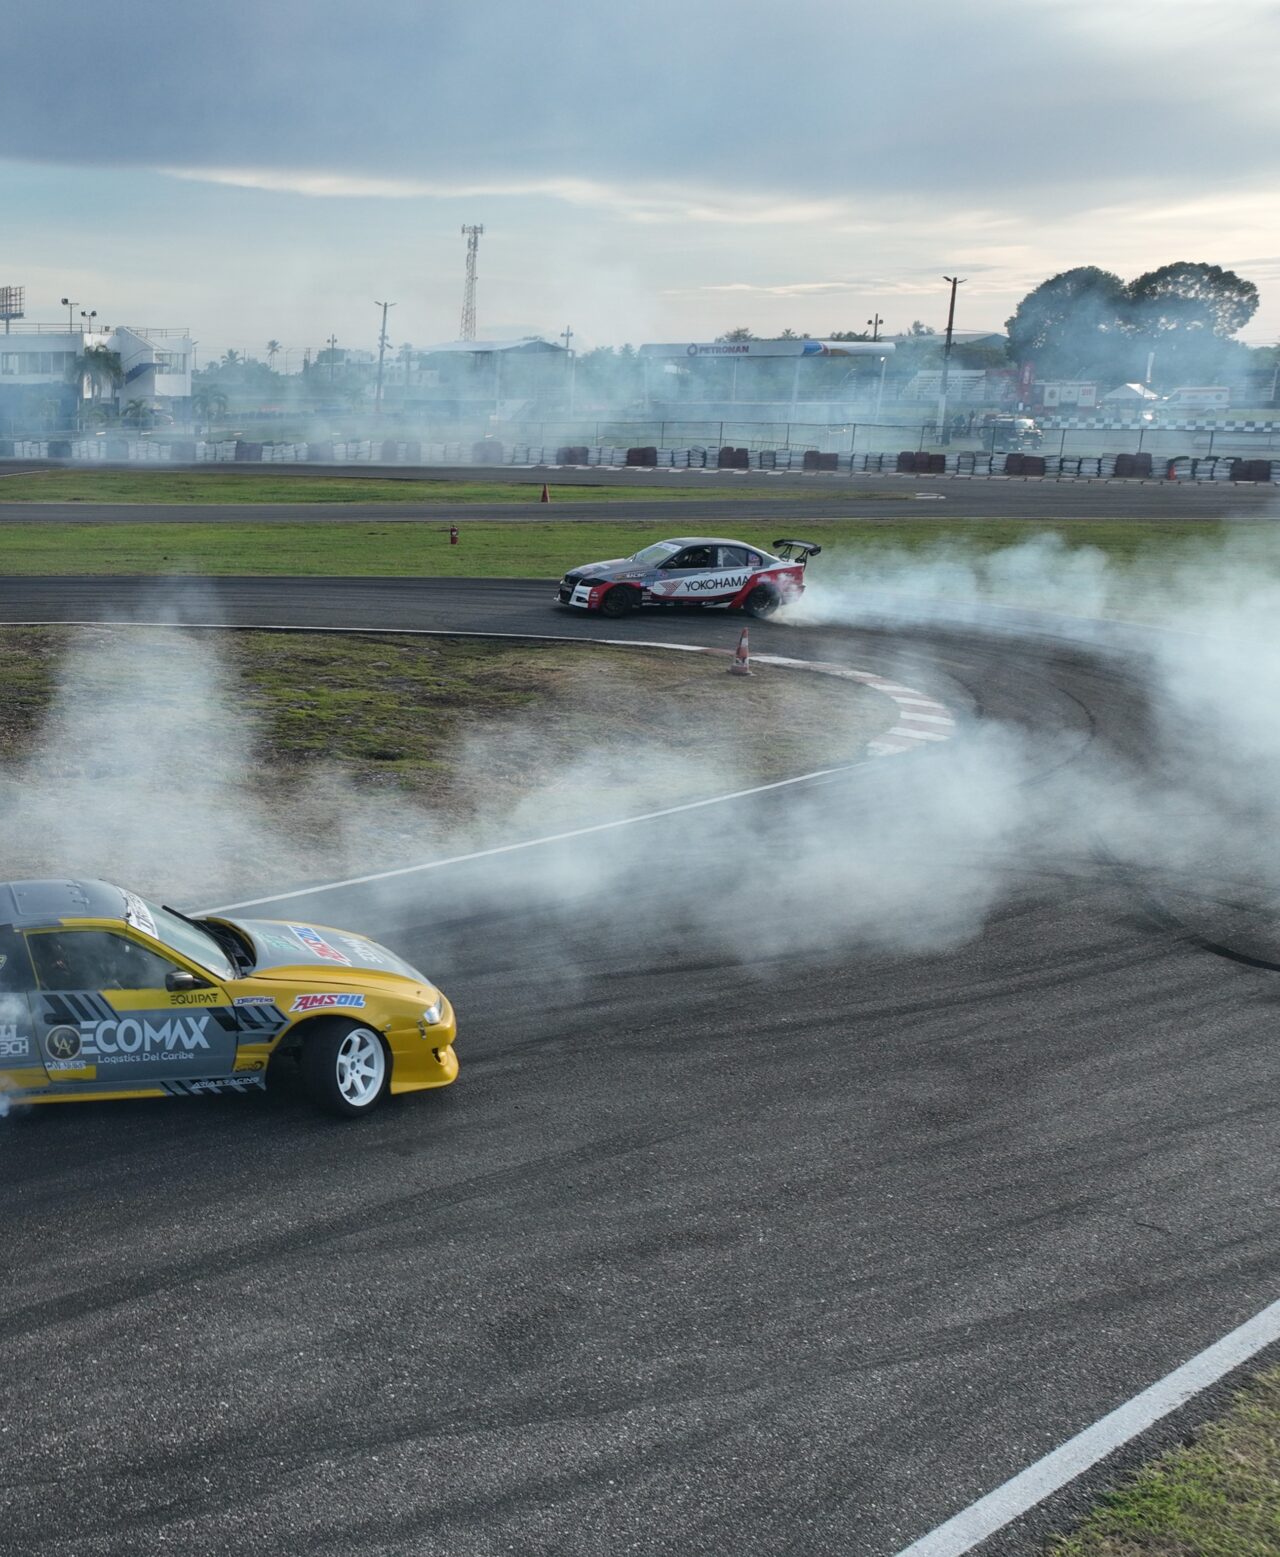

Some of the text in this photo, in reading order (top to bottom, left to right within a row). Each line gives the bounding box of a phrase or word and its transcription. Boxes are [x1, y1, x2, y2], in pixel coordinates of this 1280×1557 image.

[685, 576, 749, 592] YOKOHAMA
[293, 994, 365, 1010] AMSOIL
[80, 1016, 211, 1055] ECOMAX
[97, 1050, 195, 1064] Logistics Del Caribe
